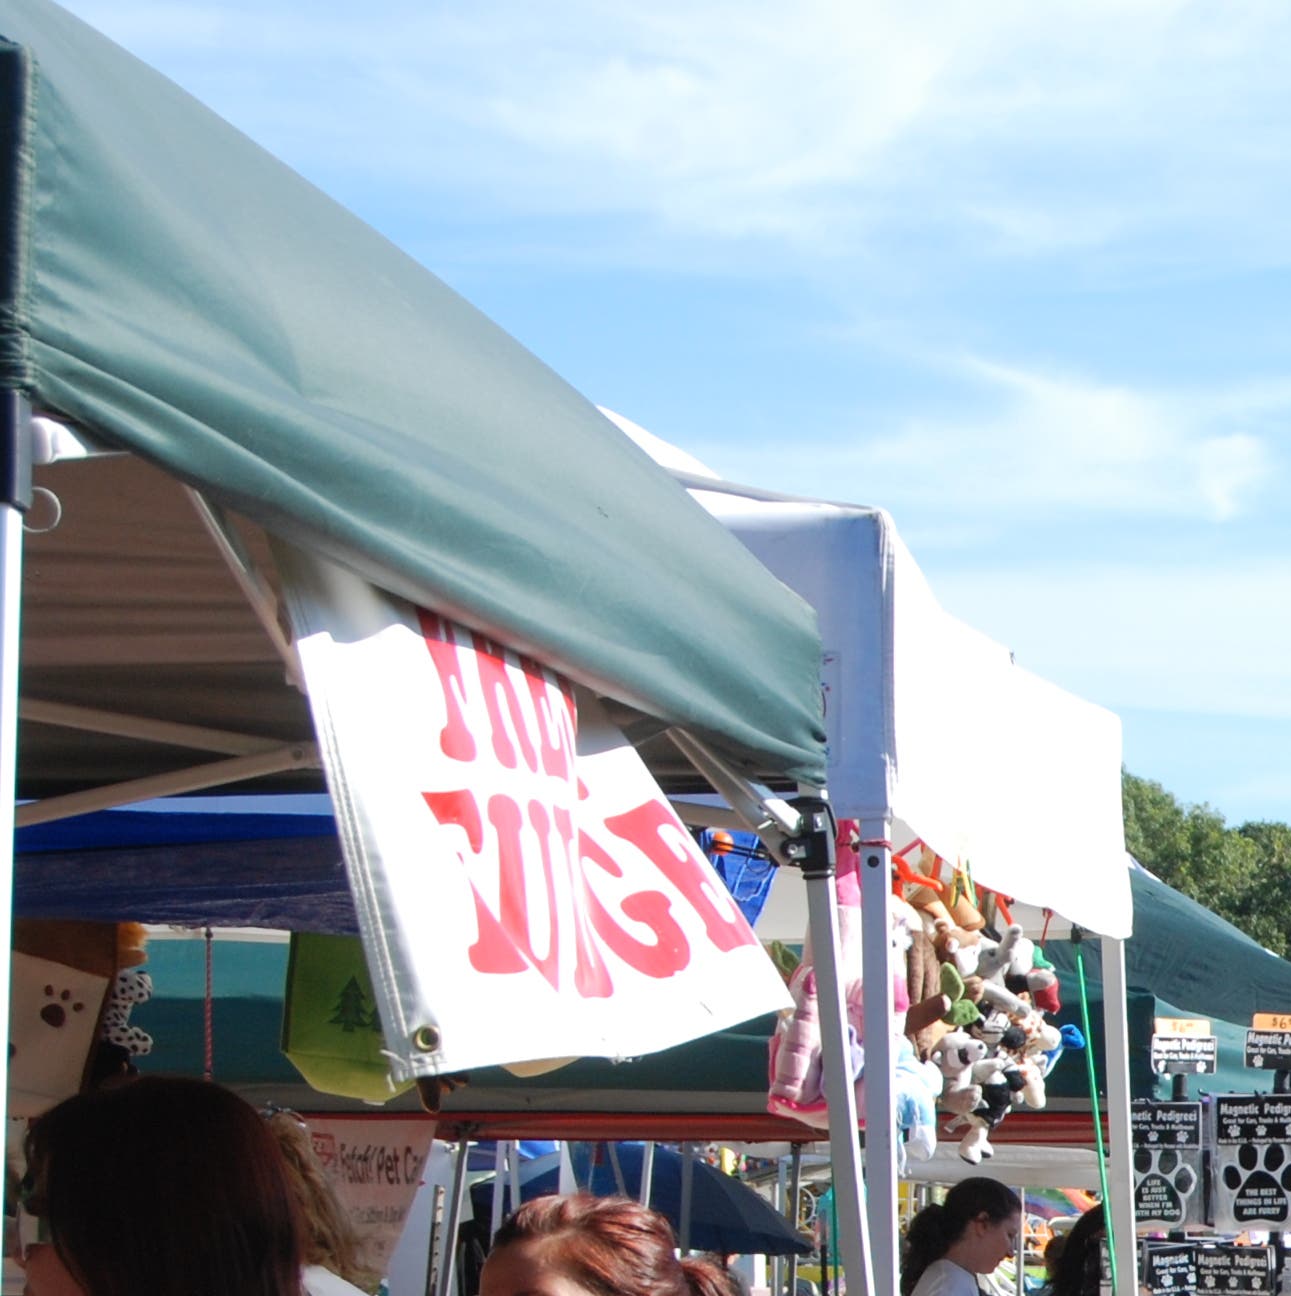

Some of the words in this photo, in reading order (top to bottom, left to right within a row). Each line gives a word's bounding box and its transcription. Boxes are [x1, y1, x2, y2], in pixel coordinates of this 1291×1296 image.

[1131, 1111, 1152, 1121] netic
[1220, 1103, 1259, 1117] Magnetic
[377, 1146, 400, 1184] Pet
[1198, 1254, 1231, 1267] Magnetic
